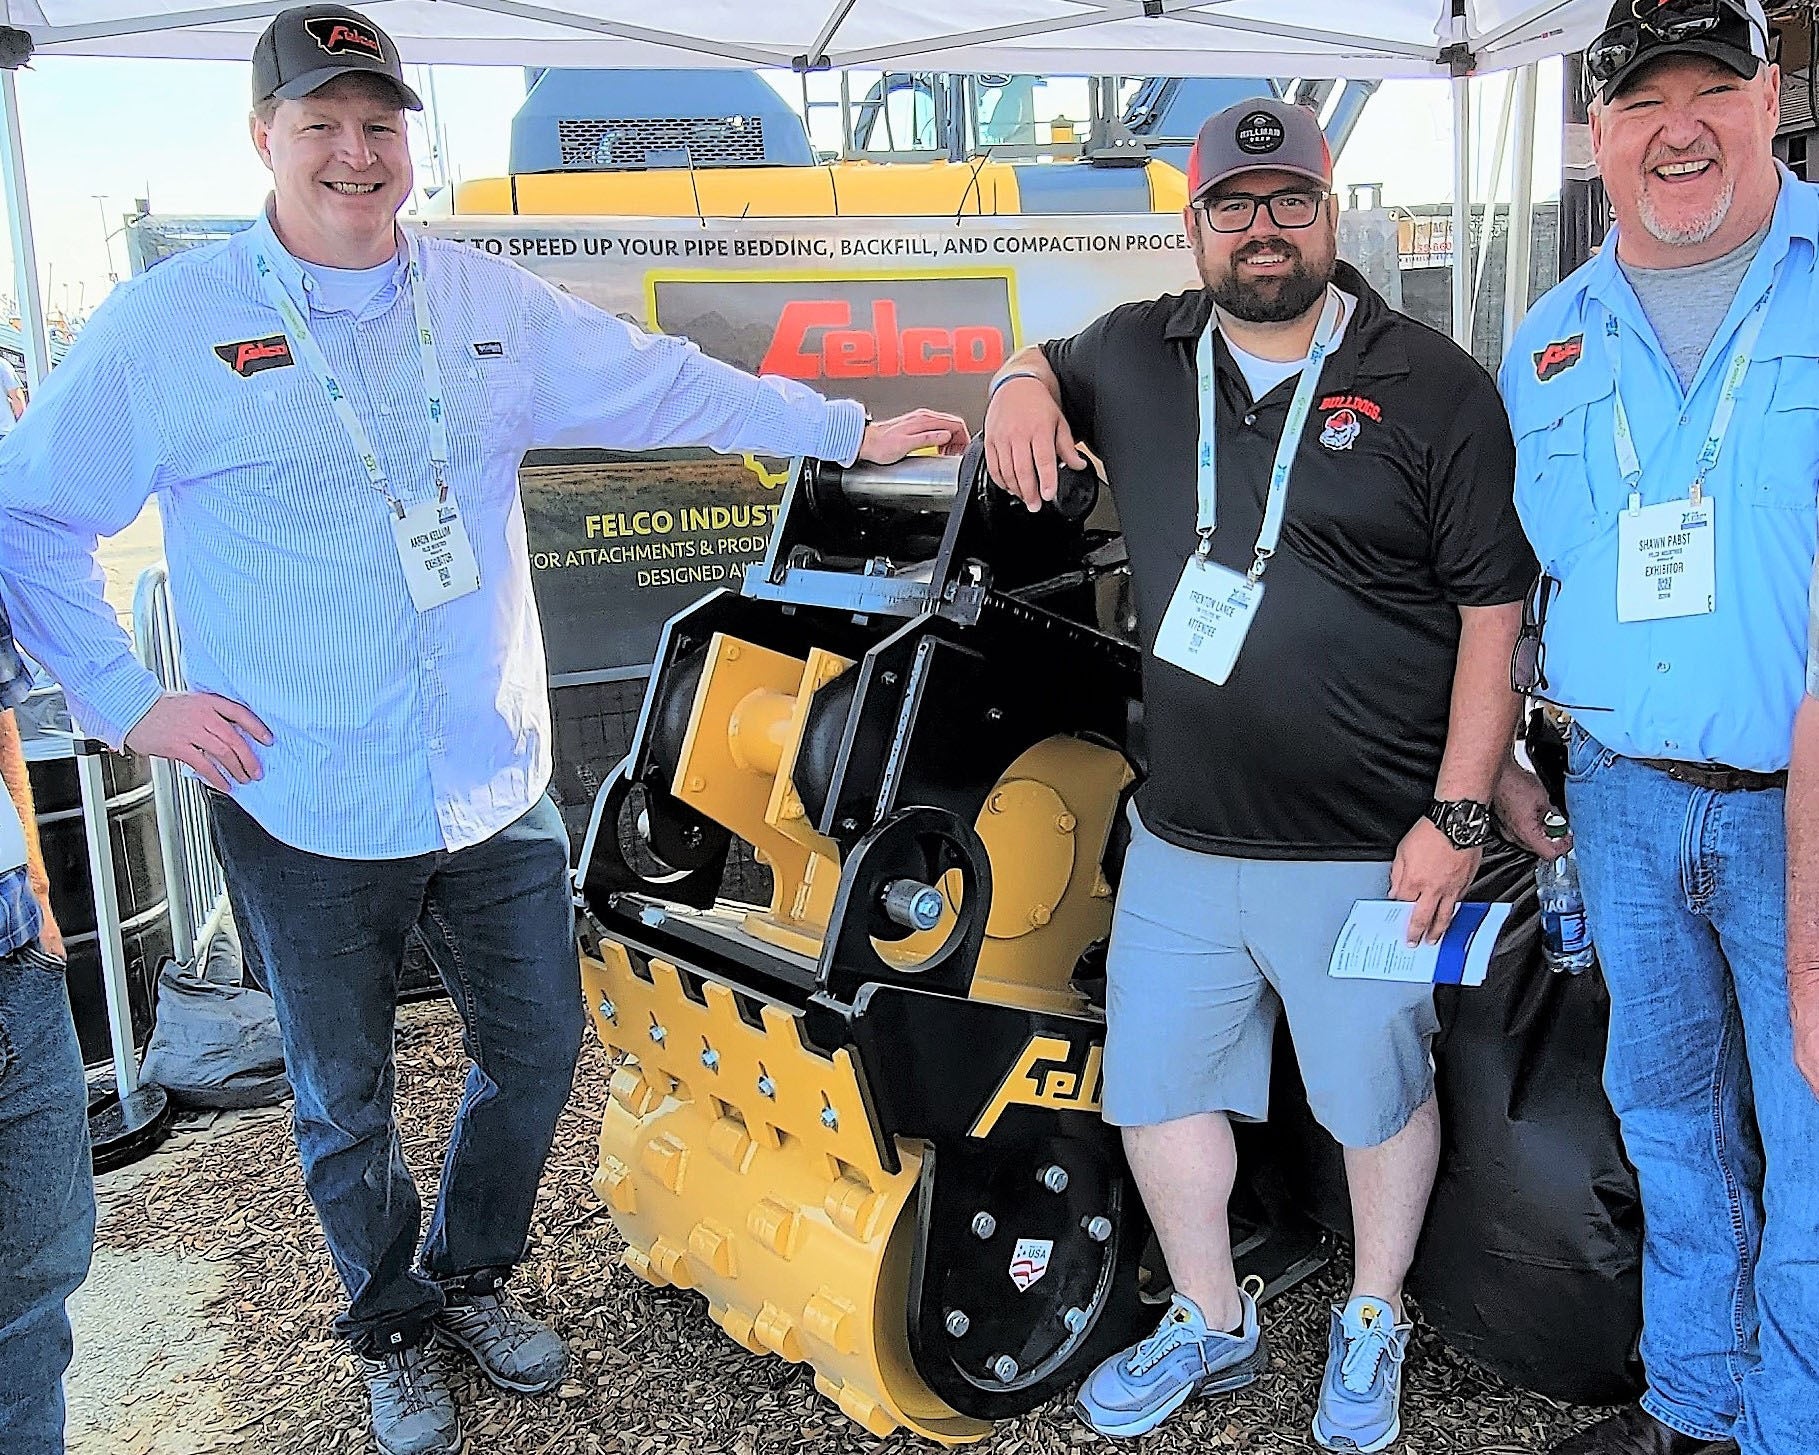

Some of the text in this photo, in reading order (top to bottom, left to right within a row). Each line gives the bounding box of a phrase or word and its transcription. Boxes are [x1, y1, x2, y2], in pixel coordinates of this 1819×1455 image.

[471, 234, 1192, 259] TO SPEED UP YOUR PIPE BEDDING, BACKFILL, AND COMPACTION PROCE
[757, 299, 1004, 380] Felco
[585, 510, 673, 539] FELCO
[529, 534, 769, 570] OR ATTACHMENTS & PROD
[1639, 533, 1691, 552] SHAWN PABST
[637, 565, 725, 587] DESIGNED
[1645, 562, 1684, 577] EXHIBITOR
[1028, 1248, 1047, 1259] USA
